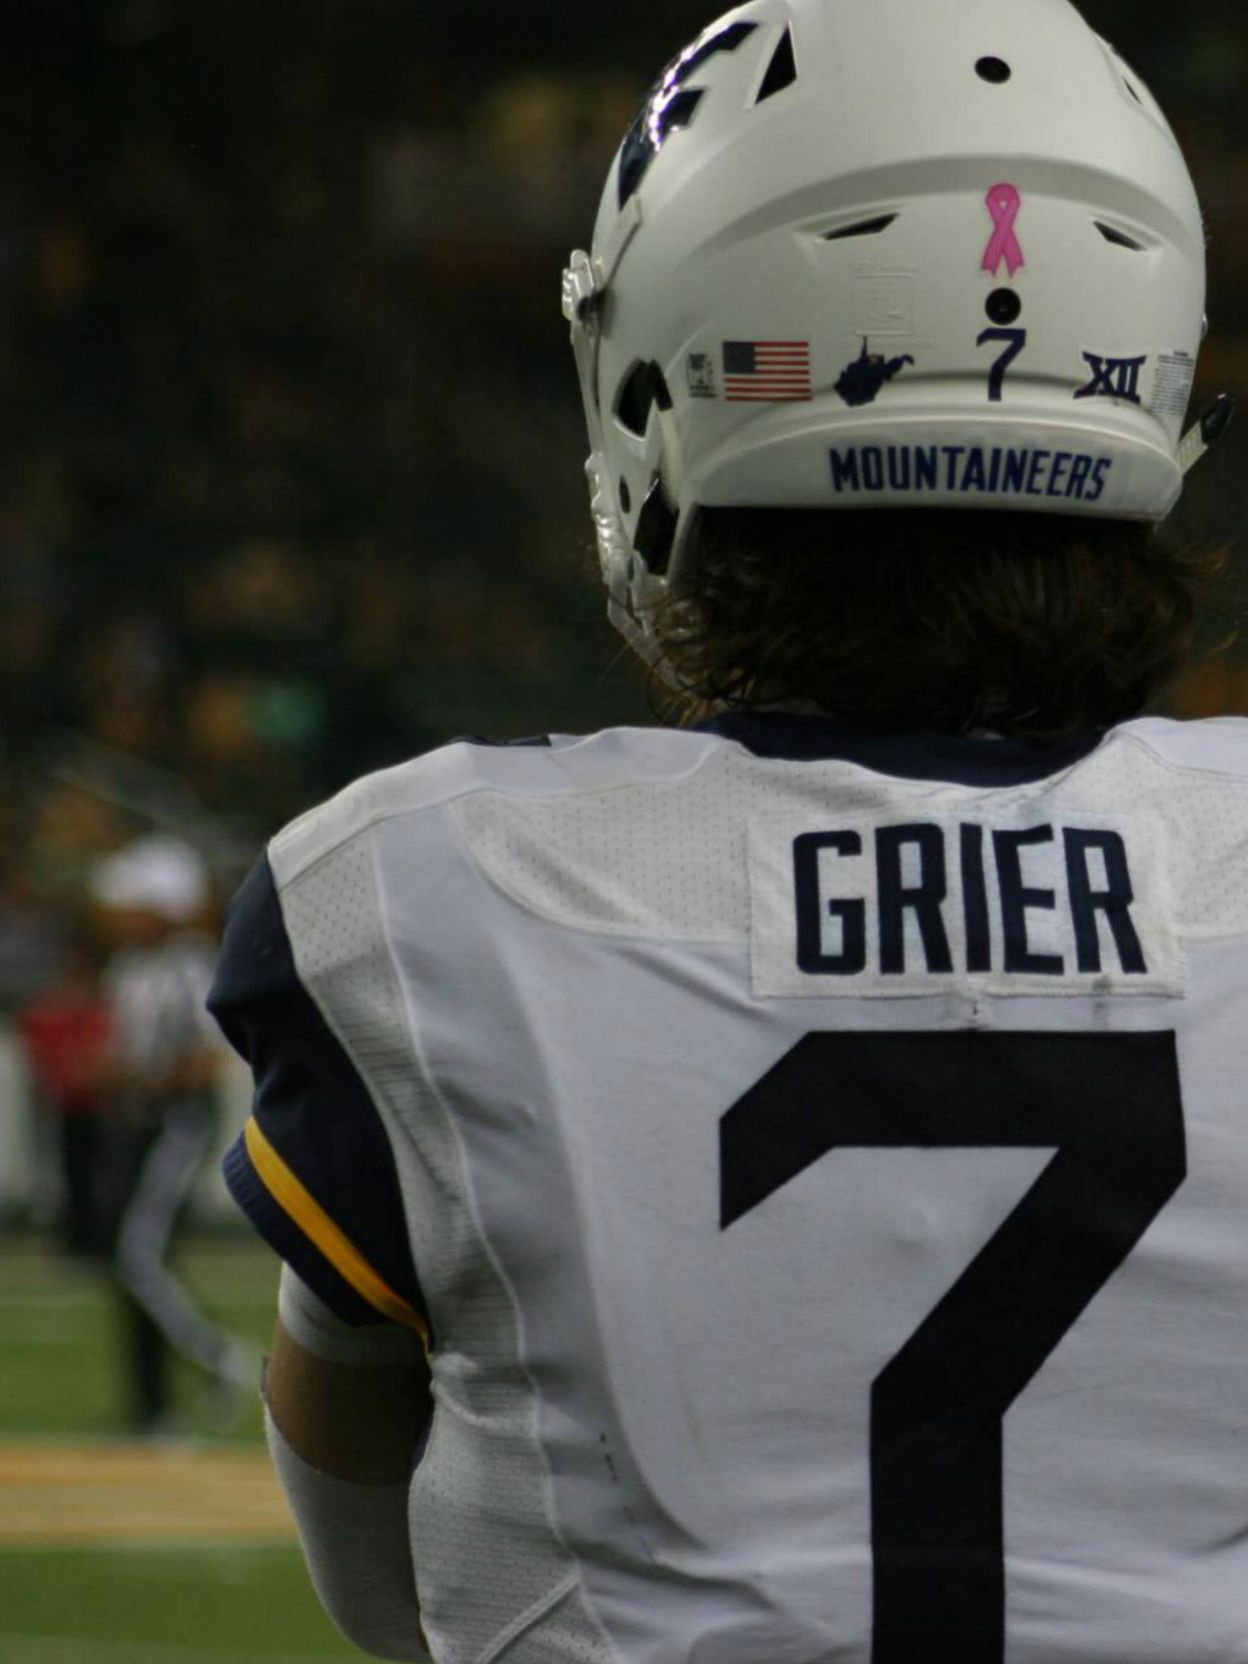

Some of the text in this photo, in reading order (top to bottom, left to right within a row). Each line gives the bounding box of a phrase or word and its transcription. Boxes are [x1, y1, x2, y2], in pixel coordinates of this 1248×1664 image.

[976, 327, 1026, 402] 7
[1073, 351, 1147, 405] XII
[829, 445, 1112, 501] MOUNTAINEERS
[792, 821, 1147, 976] GRIER
[719, 1030, 1187, 1664] 7
